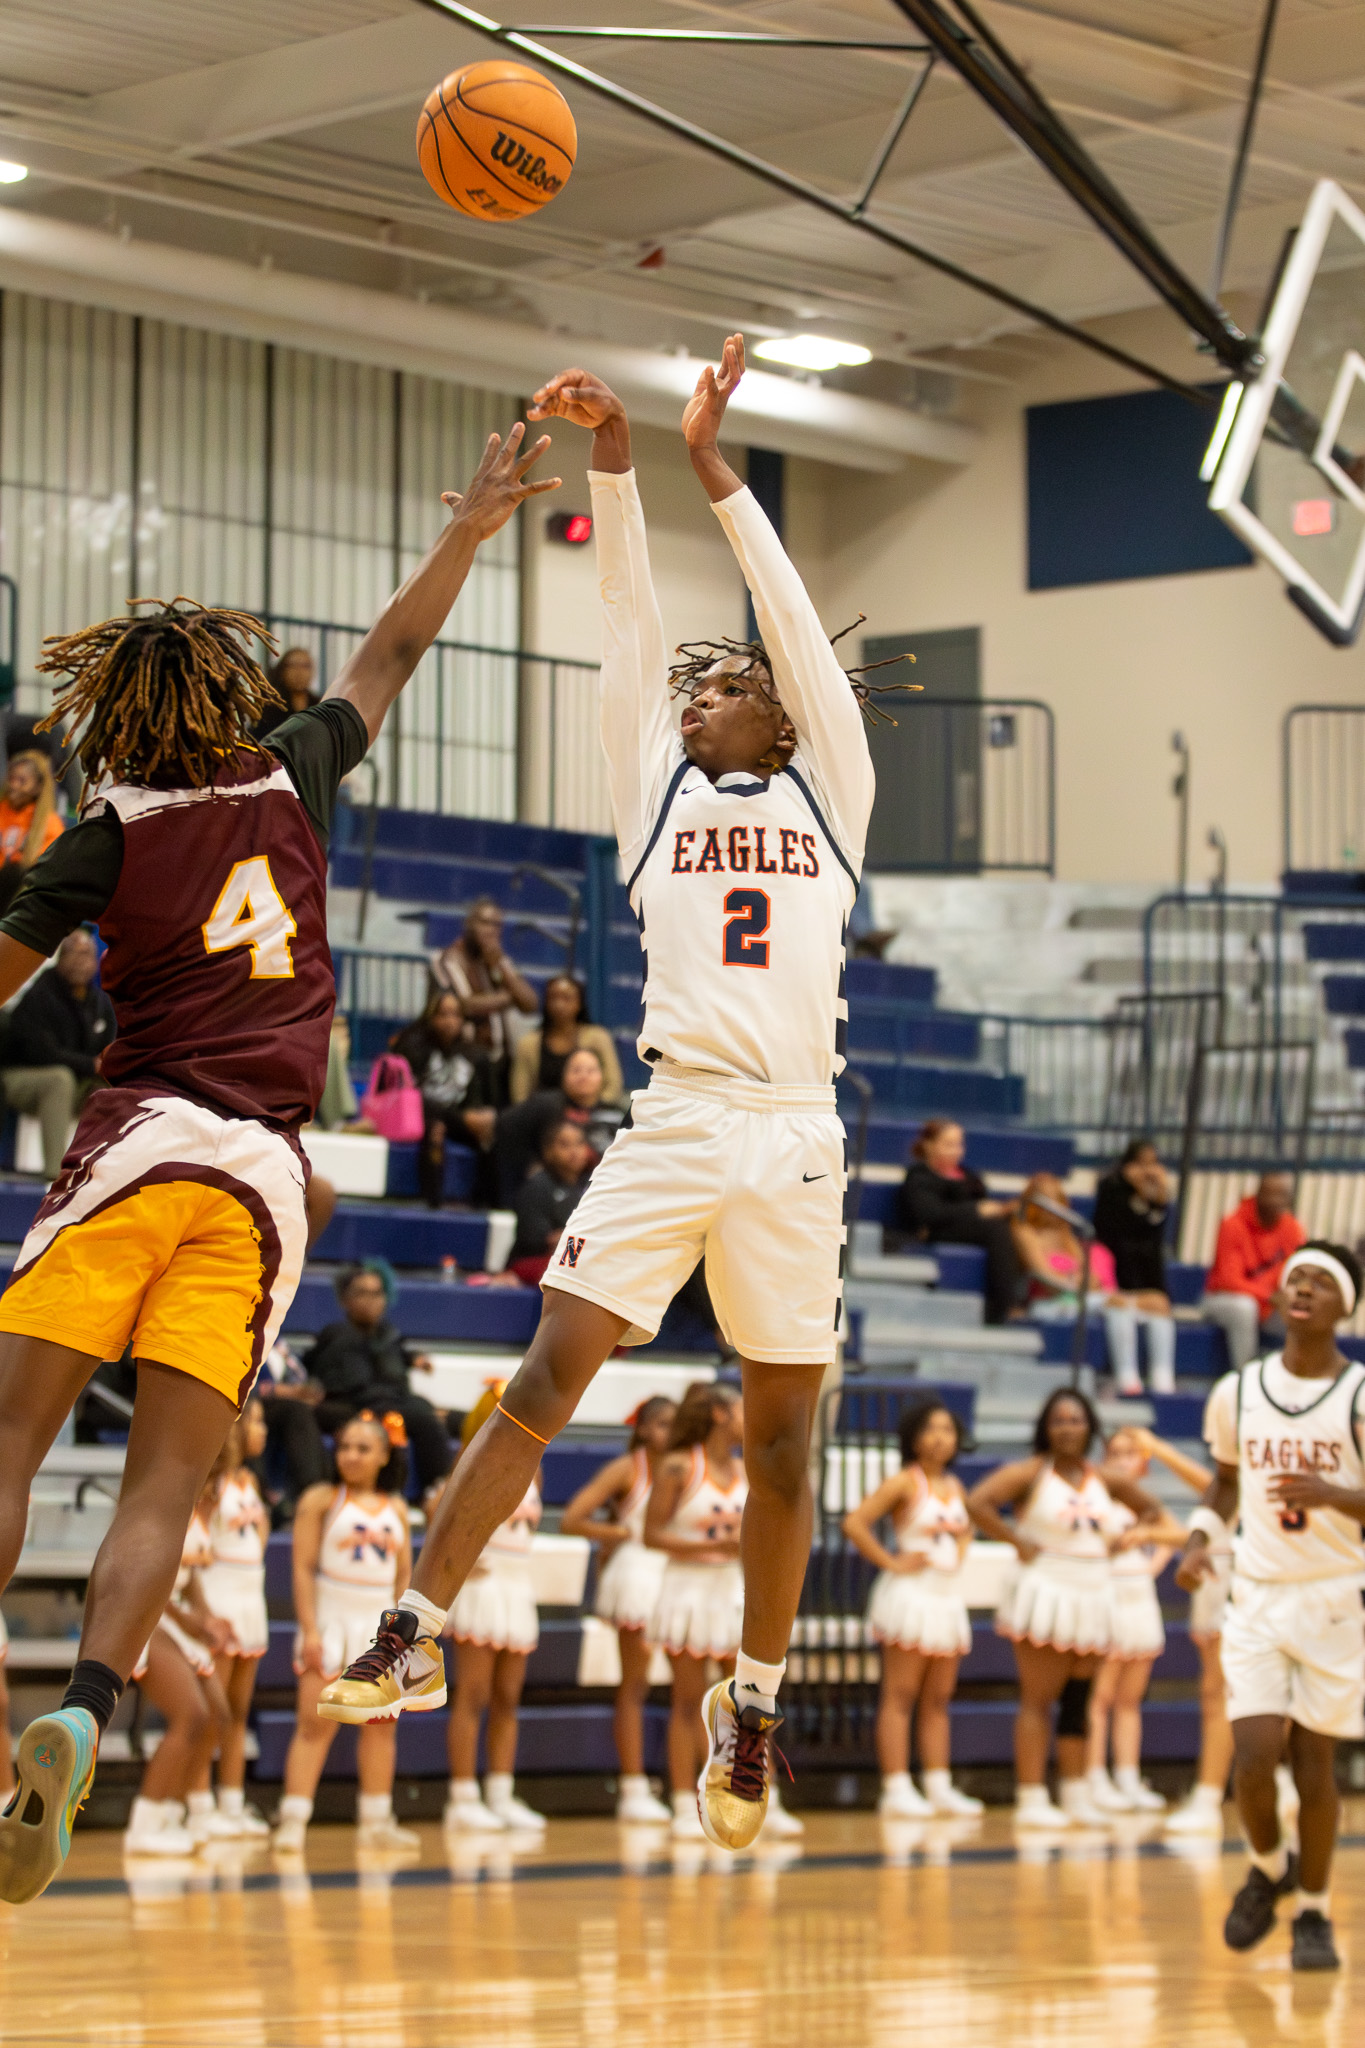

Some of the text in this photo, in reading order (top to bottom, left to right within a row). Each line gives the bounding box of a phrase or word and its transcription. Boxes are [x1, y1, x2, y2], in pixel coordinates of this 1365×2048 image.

[671, 826, 820, 878] EAGLES
[201, 855, 297, 979] 4
[722, 887, 771, 969] 2
[559, 1236, 586, 1268] N
